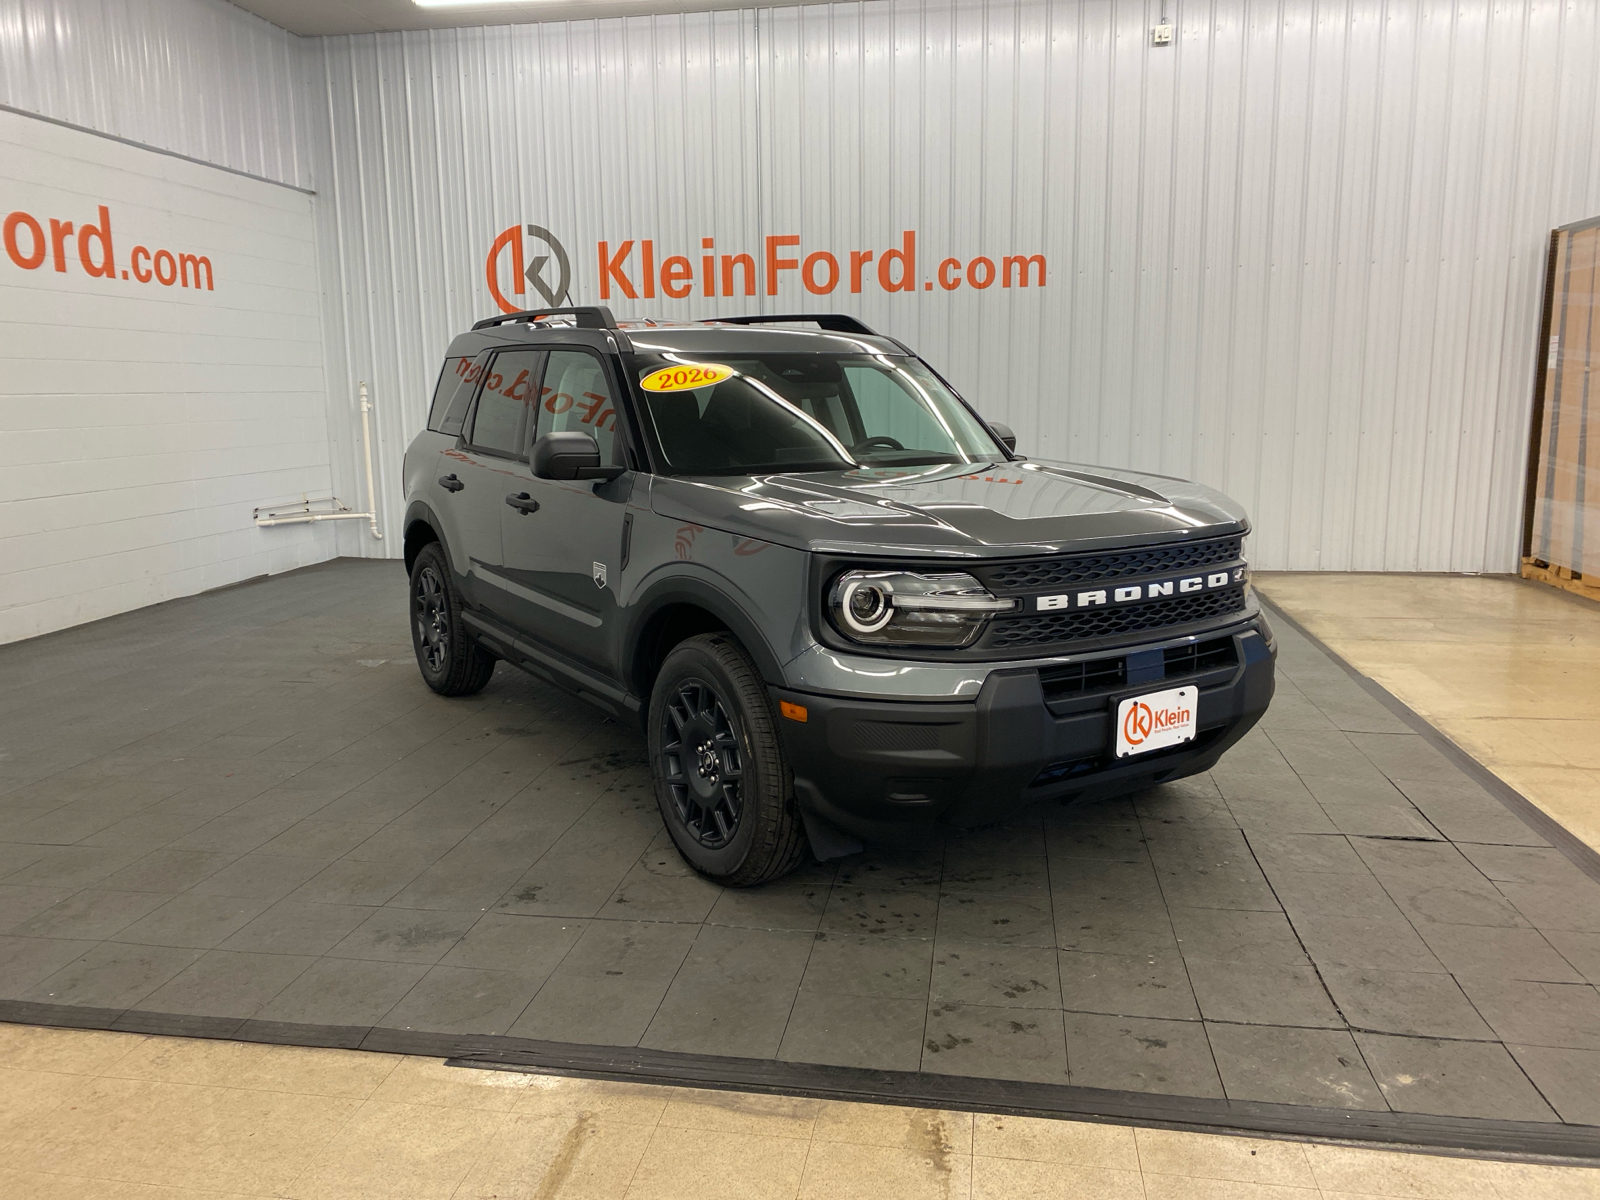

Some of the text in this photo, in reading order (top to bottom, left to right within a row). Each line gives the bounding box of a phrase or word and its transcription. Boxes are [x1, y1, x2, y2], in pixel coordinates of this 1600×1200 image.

[597, 229, 1047, 300] KleinFord.com
[658, 367, 718, 390] 2026
[1036, 572, 1229, 611] BRONCO
[1154, 706, 1190, 729] Klein
